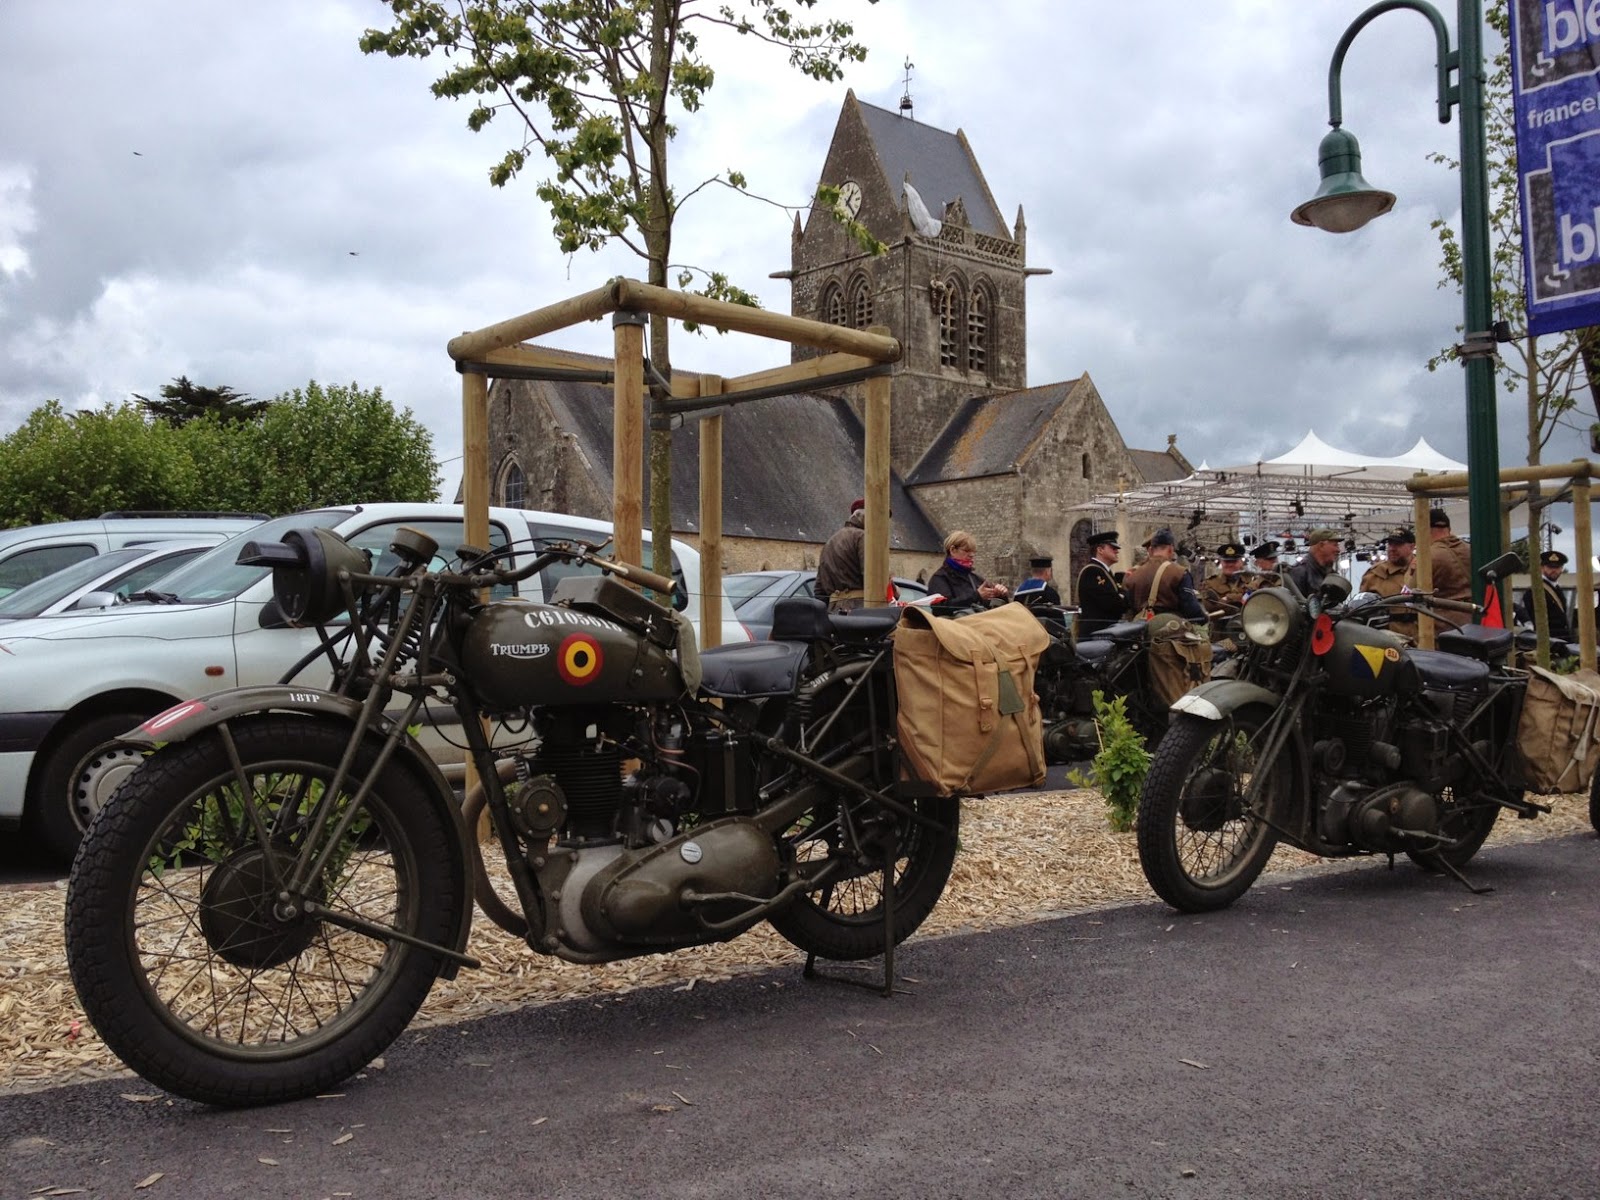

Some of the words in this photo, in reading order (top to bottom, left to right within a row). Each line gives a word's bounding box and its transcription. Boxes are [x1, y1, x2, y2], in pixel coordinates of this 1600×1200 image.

[1527, 91, 1600, 129] france
[490, 643, 550, 659] TRIUMPH
[289, 692, 320, 703] 18TP
